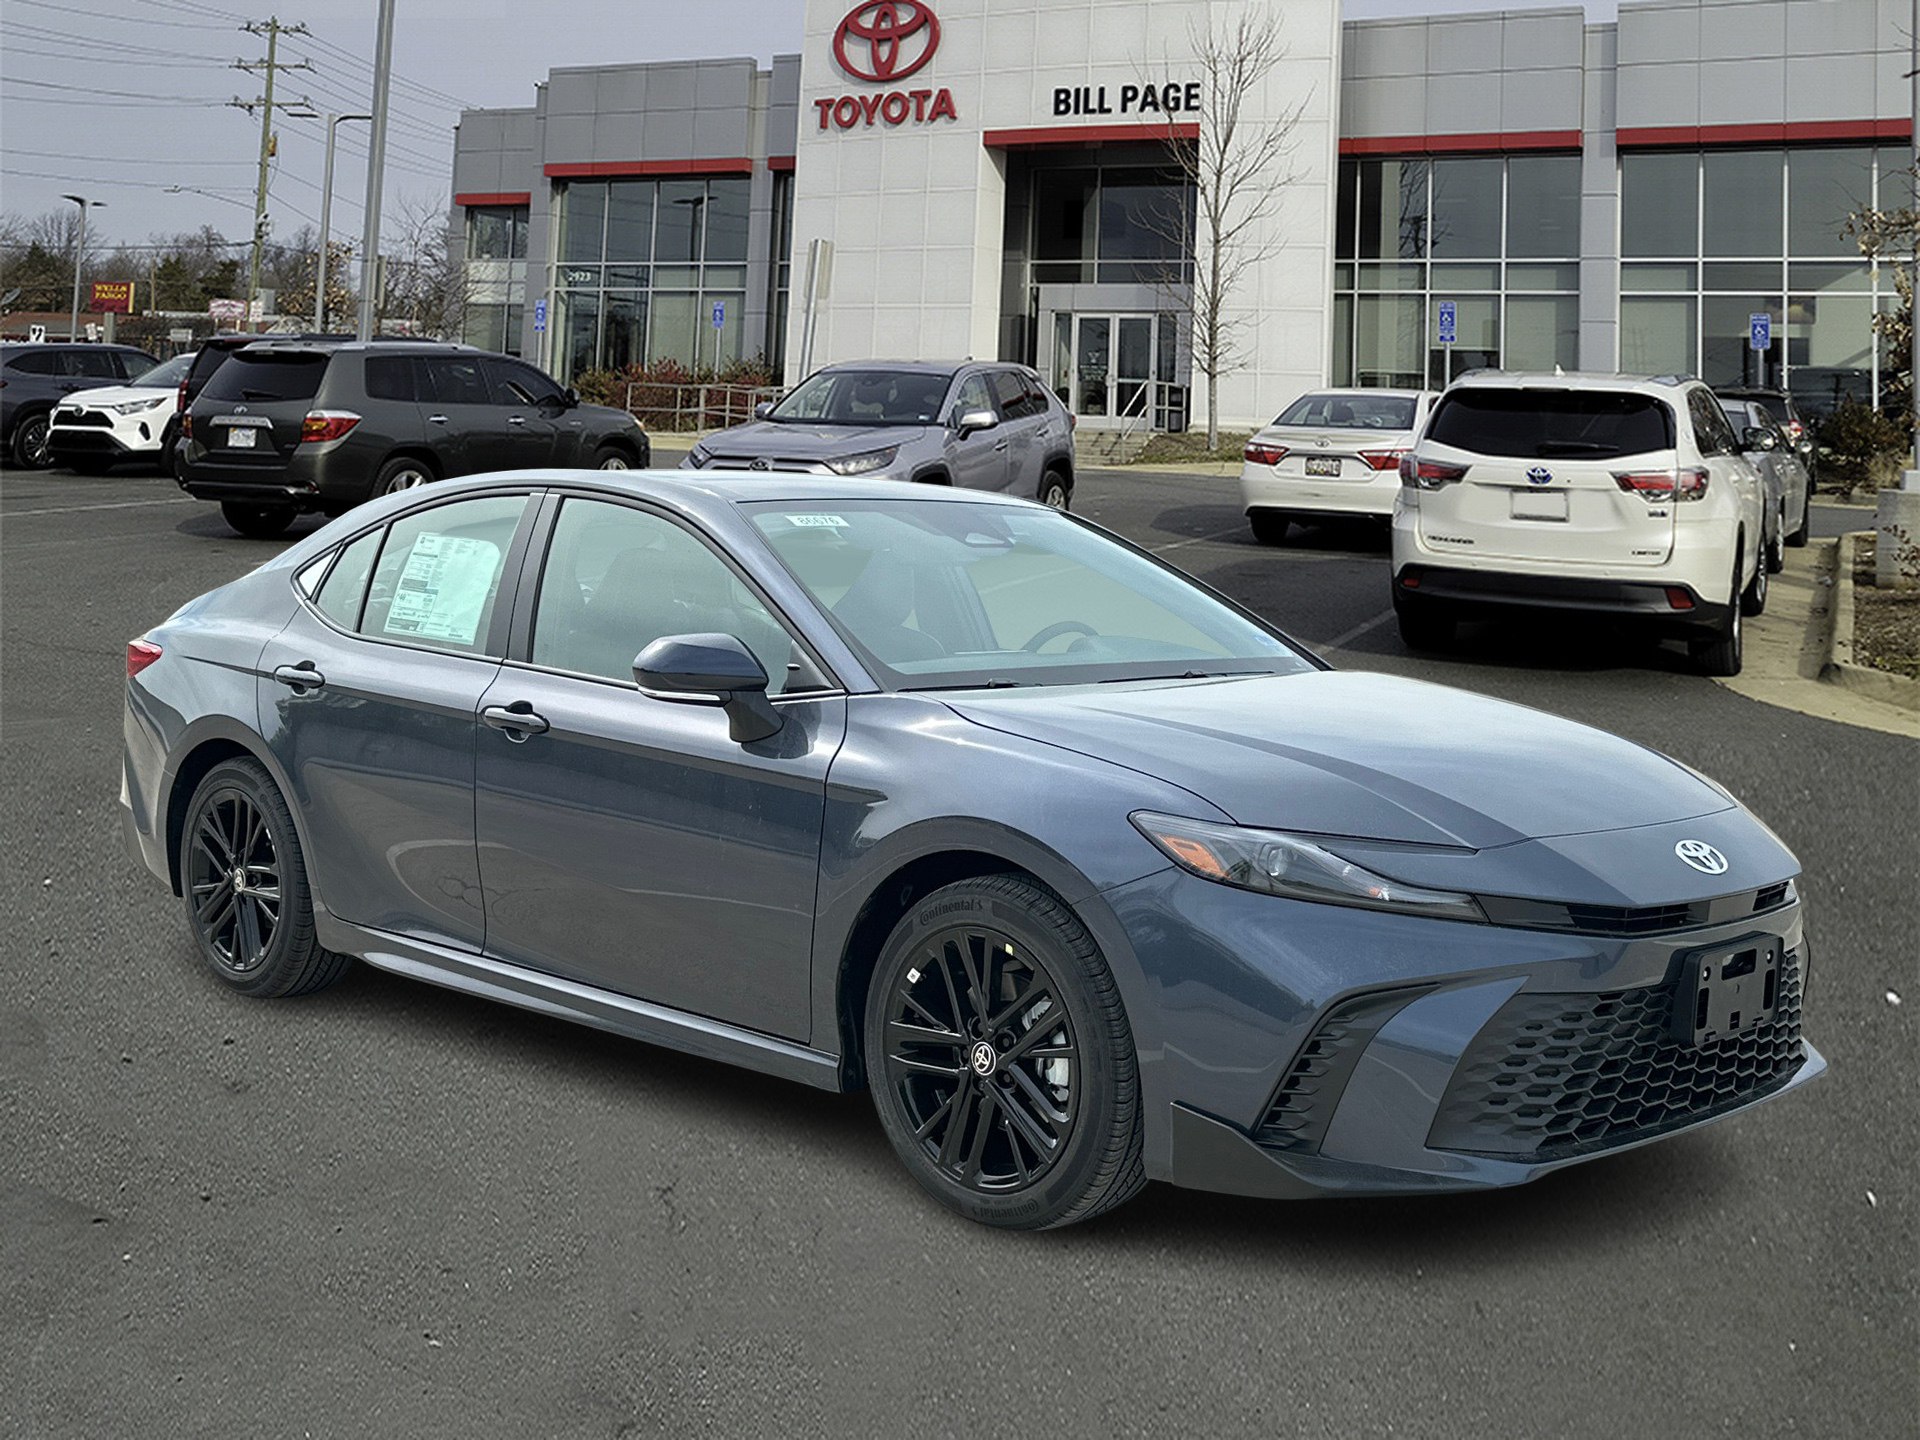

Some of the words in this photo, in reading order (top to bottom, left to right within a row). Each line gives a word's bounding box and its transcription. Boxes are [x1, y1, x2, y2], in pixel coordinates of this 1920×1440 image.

[814, 88, 957, 129] TOYOTA
[1054, 86, 1112, 116] BILL
[1121, 83, 1200, 113] PAGE
[920, 898, 975, 926] Continental
